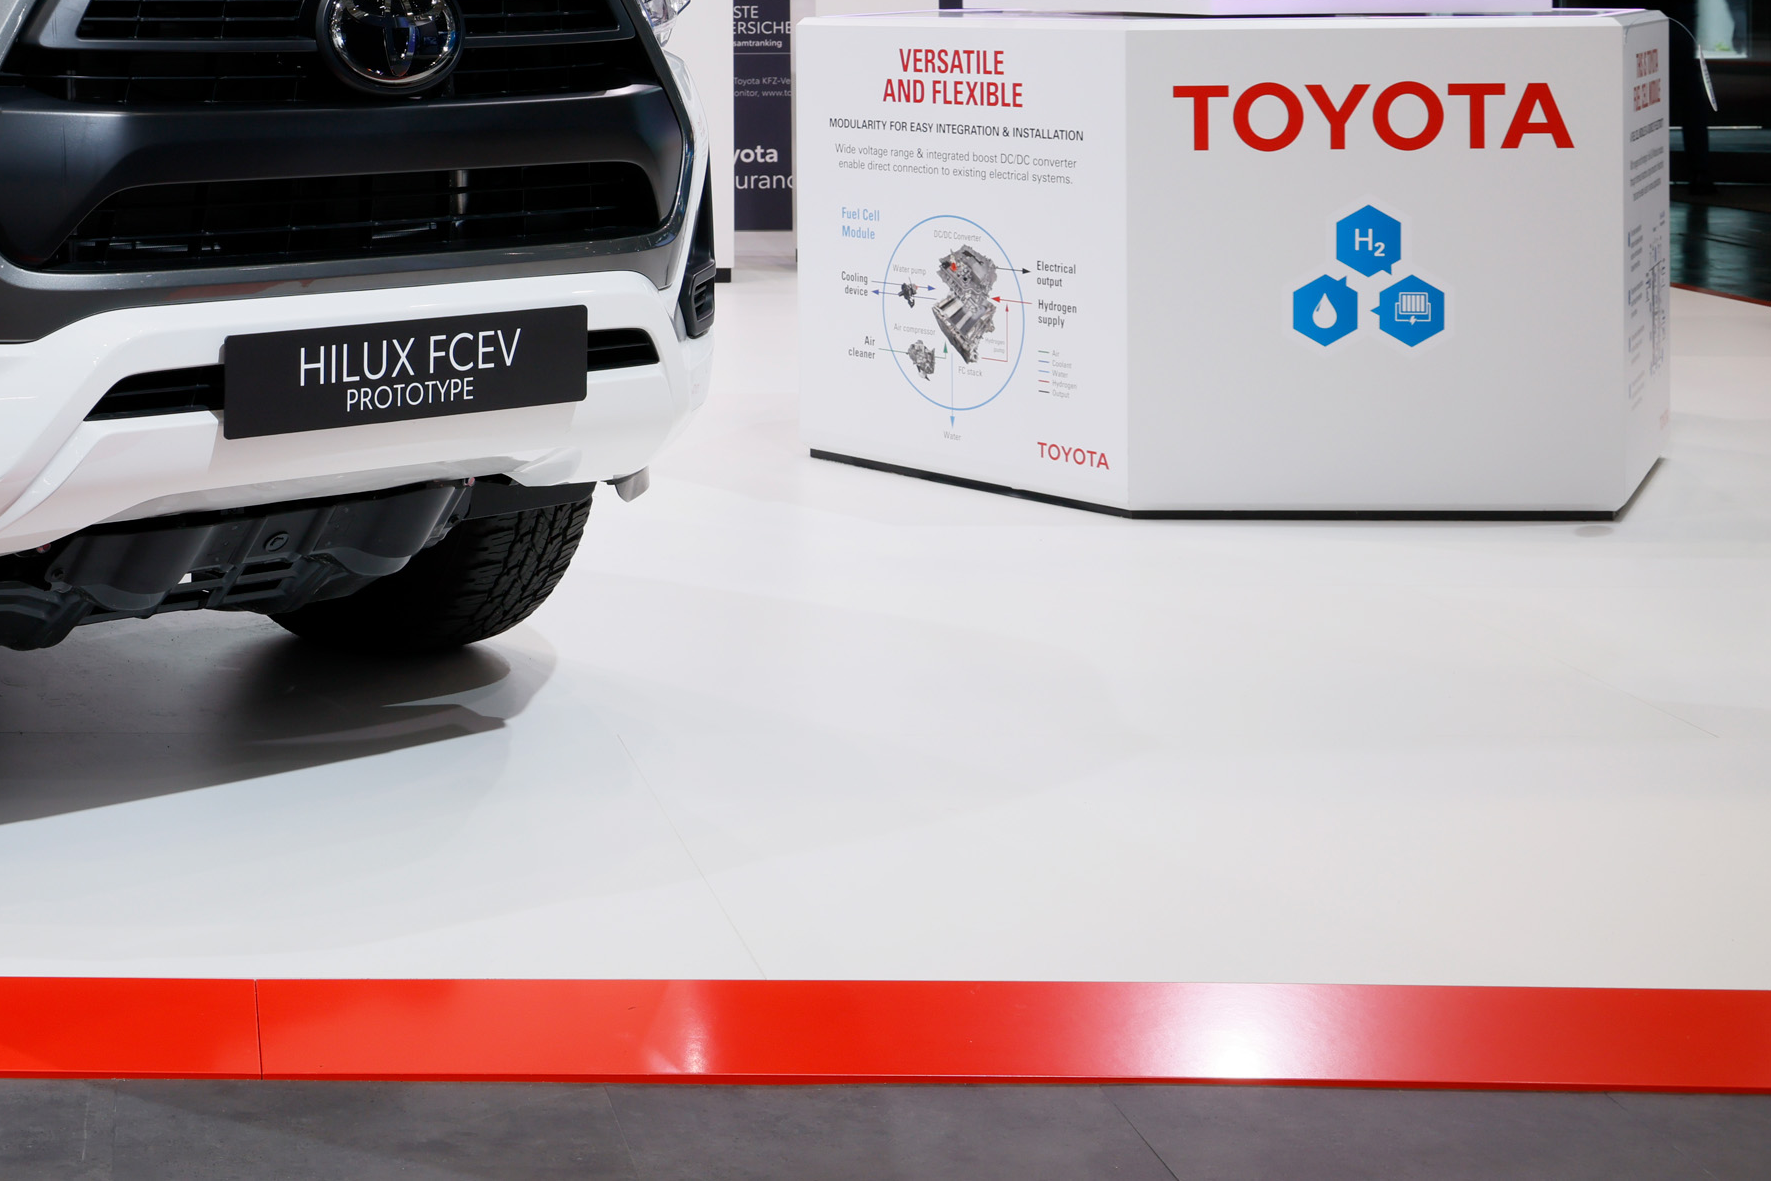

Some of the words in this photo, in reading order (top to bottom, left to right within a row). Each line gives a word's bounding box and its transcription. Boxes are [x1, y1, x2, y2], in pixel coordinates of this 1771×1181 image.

[733, 5, 759, 19] STE
[733, 38, 783, 49] samtranking
[899, 48, 1004, 75] VERSATILE
[883, 79, 925, 104] AND
[932, 80, 1023, 108] FLEXIBLE
[1172, 80, 1575, 152] TOYOTA
[829, 118, 887, 131] MODULARITY
[889, 120, 908, 132] FOR
[910, 122, 934, 134] EASY
[936, 123, 1000, 137] INTEGRATION
[1002, 126, 1010, 137] &
[1012, 127, 1084, 141] INSTALLATION
[734, 145, 779, 165] yota
[835, 143, 856, 155] Wide
[858, 144, 888, 158] voltage
[890, 149, 915, 160] range
[916, 148, 924, 159] &
[926, 149, 970, 164] integrated
[972, 151, 998, 163] boost
[1000, 153, 1030, 166] DC/DC
[1032, 157, 1077, 169] converter
[838, 159, 865, 170] enable
[867, 160, 891, 172] direct
[893, 162, 939, 175] connection
[941, 164, 950, 176] to
[952, 165, 987, 181] existing
[989, 167, 1029, 181] electrical
[1031, 171, 1073, 185] systems.
[841, 207, 860, 221] Fuel
[862, 208, 880, 222] Cell
[842, 225, 876, 240] Module
[933, 229, 952, 241] DC/DC
[953, 230, 982, 243] Converter
[1354, 228, 1386, 257] H2
[893, 264, 909, 275] Water
[910, 267, 927, 277] pump
[1036, 260, 1077, 274] Electrical
[841, 271, 869, 286] Cooling
[1036, 277, 1063, 288] output
[844, 285, 869, 297] device
[1037, 298, 1078, 314] Hydrogen
[1037, 315, 1066, 328] supply
[893, 323, 903, 332] Air
[904, 325, 936, 336] compressor
[864, 336, 876, 346] Air
[299, 337, 416, 387] HILUX
[428, 327, 522, 375] FCEV
[848, 348, 876, 360] cleaner
[958, 365, 965, 375] FC
[966, 367, 983, 377] stack
[1052, 360, 1072, 369] Coolant
[1052, 370, 1068, 378] Water
[1052, 380, 1078, 389] Hydrogen
[346, 377, 474, 413] PROTOTYPE
[1052, 389, 1070, 399] Output
[943, 431, 961, 442] Water
[1037, 441, 1109, 470] TOYOTA
